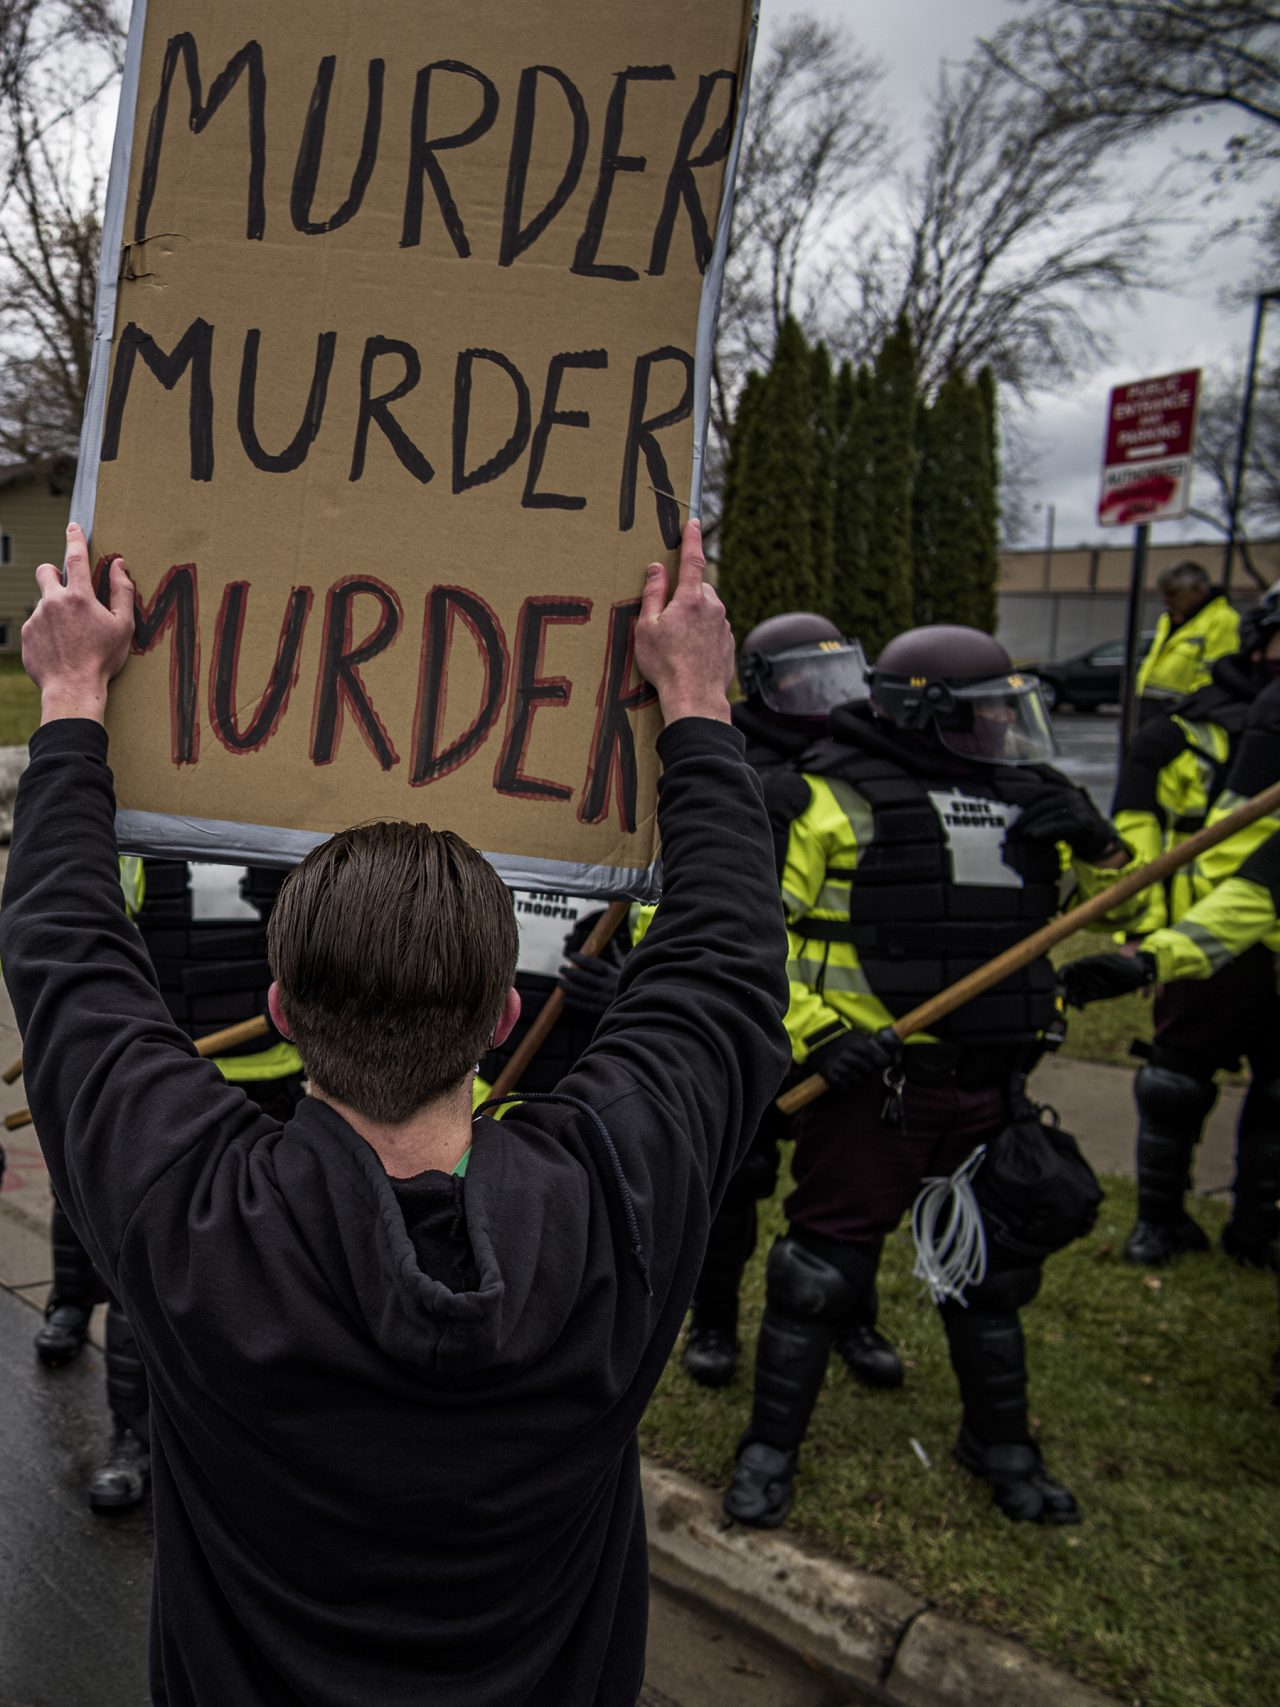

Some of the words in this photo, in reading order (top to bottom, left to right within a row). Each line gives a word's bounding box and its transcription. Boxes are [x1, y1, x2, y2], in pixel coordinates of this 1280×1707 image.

[135, 31, 738, 281] MURDER
[100, 316, 696, 551] MURDER
[93, 553, 658, 834] MURDER
[944, 813, 1006, 828] TROOPER
[951, 801, 992, 814] STATE
[516, 901, 579, 920] TROOPER
